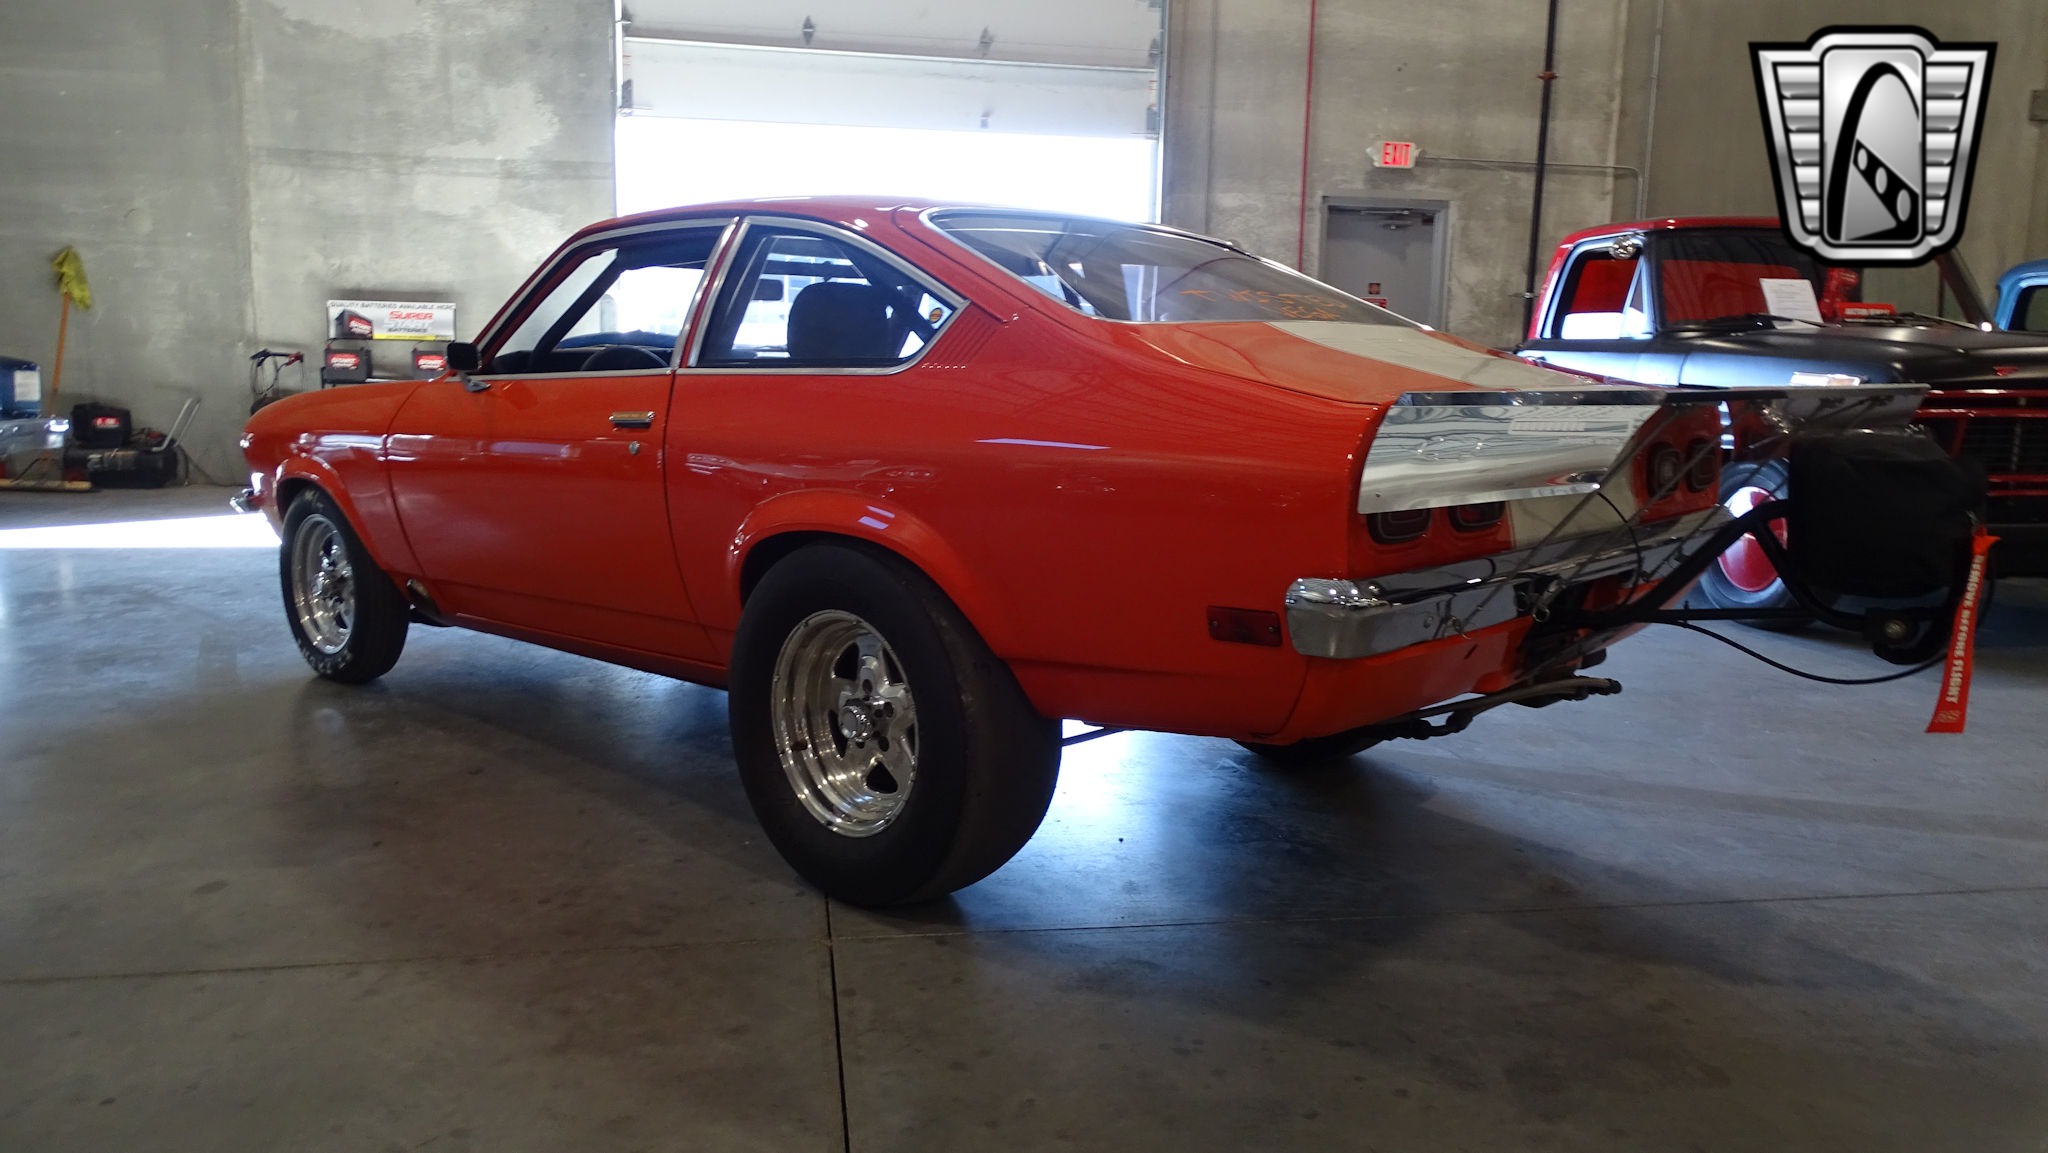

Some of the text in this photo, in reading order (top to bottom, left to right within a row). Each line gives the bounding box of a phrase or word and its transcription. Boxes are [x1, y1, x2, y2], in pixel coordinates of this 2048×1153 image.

[1383, 143, 1410, 166] EXIT
[389, 311, 433, 320] SUPER
[399, 302, 434, 310] AVAILABLE
[1964, 555, 1985, 608] REMOVE
[1954, 609, 1971, 658] BEFORE
[1946, 659, 1965, 704] FLIGHT
